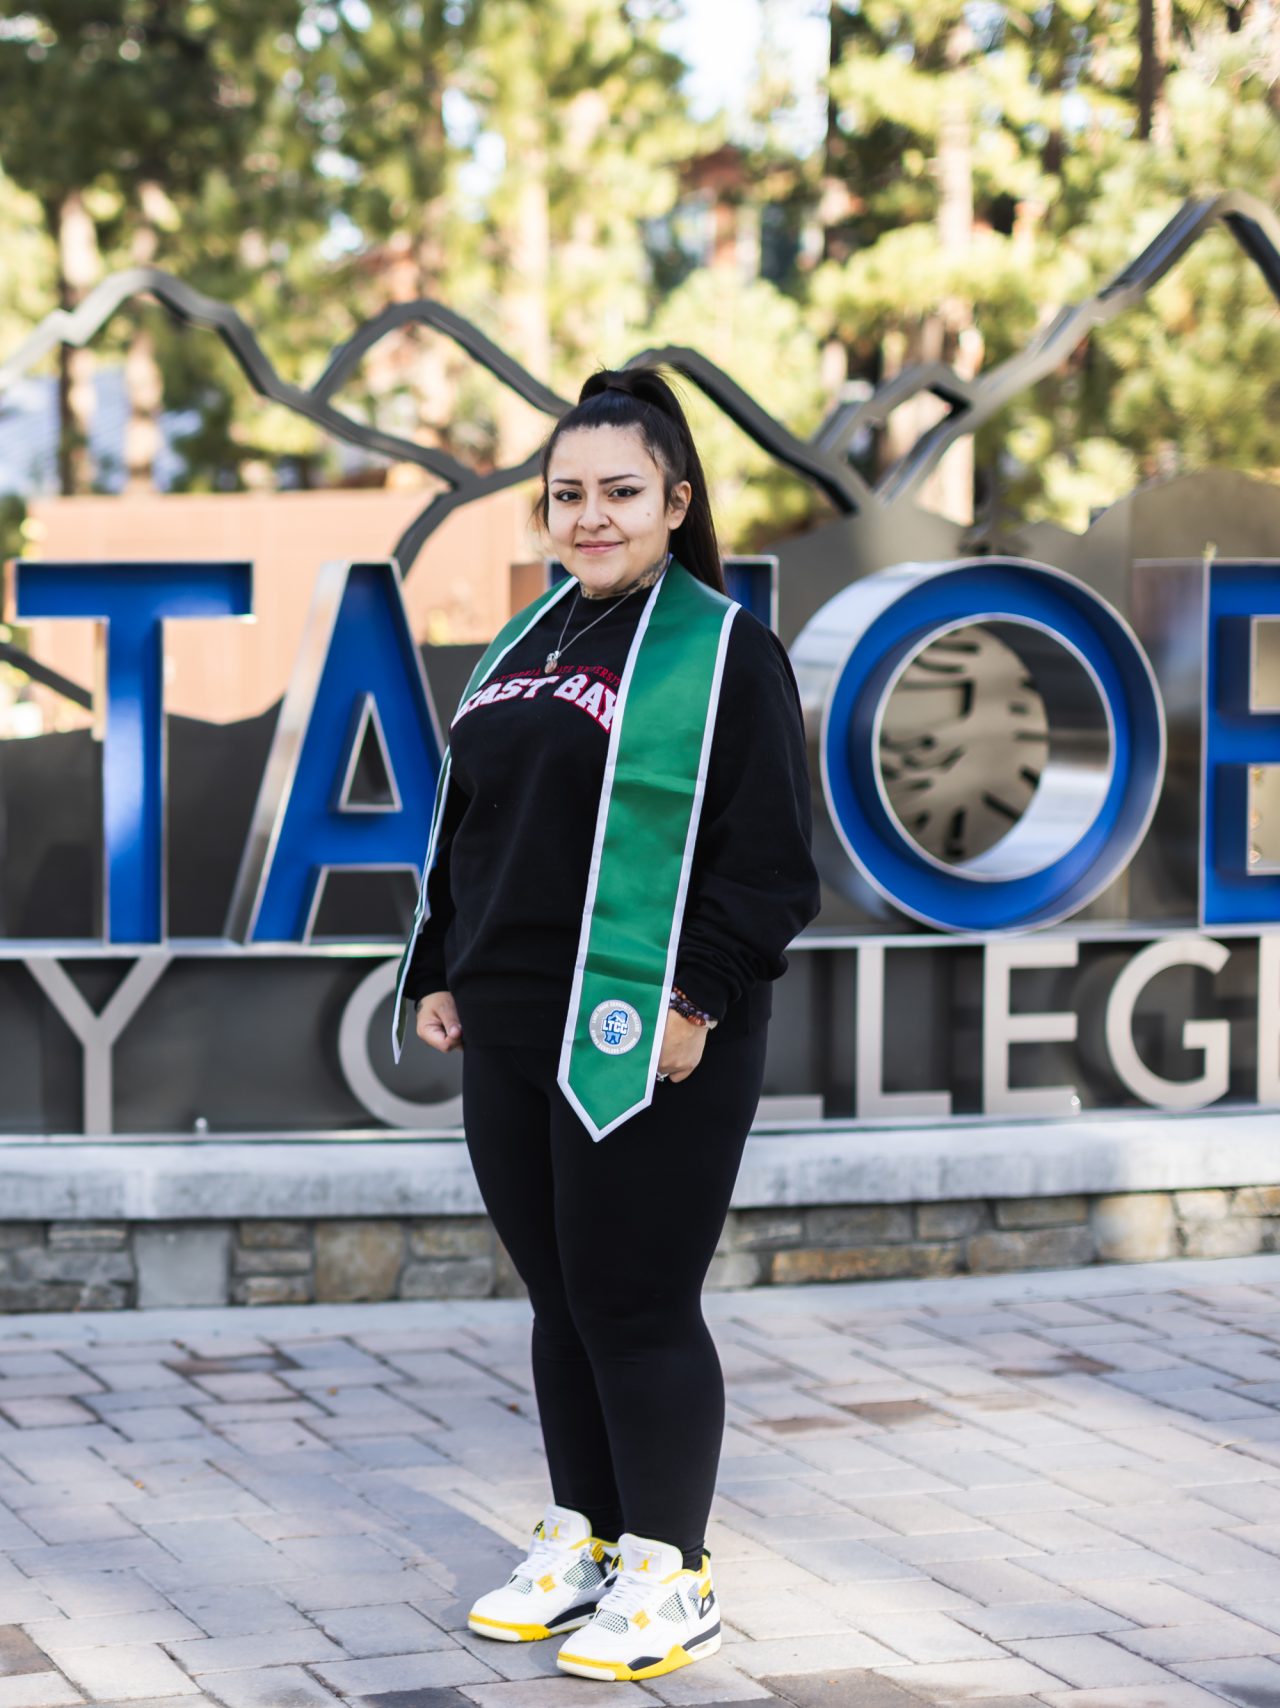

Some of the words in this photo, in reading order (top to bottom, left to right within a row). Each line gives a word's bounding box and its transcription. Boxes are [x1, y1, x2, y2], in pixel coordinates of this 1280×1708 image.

[10, 555, 1280, 946] TAOE
[337, 934, 1280, 1132] CLEG
[602, 1019, 629, 1036] LTCC
